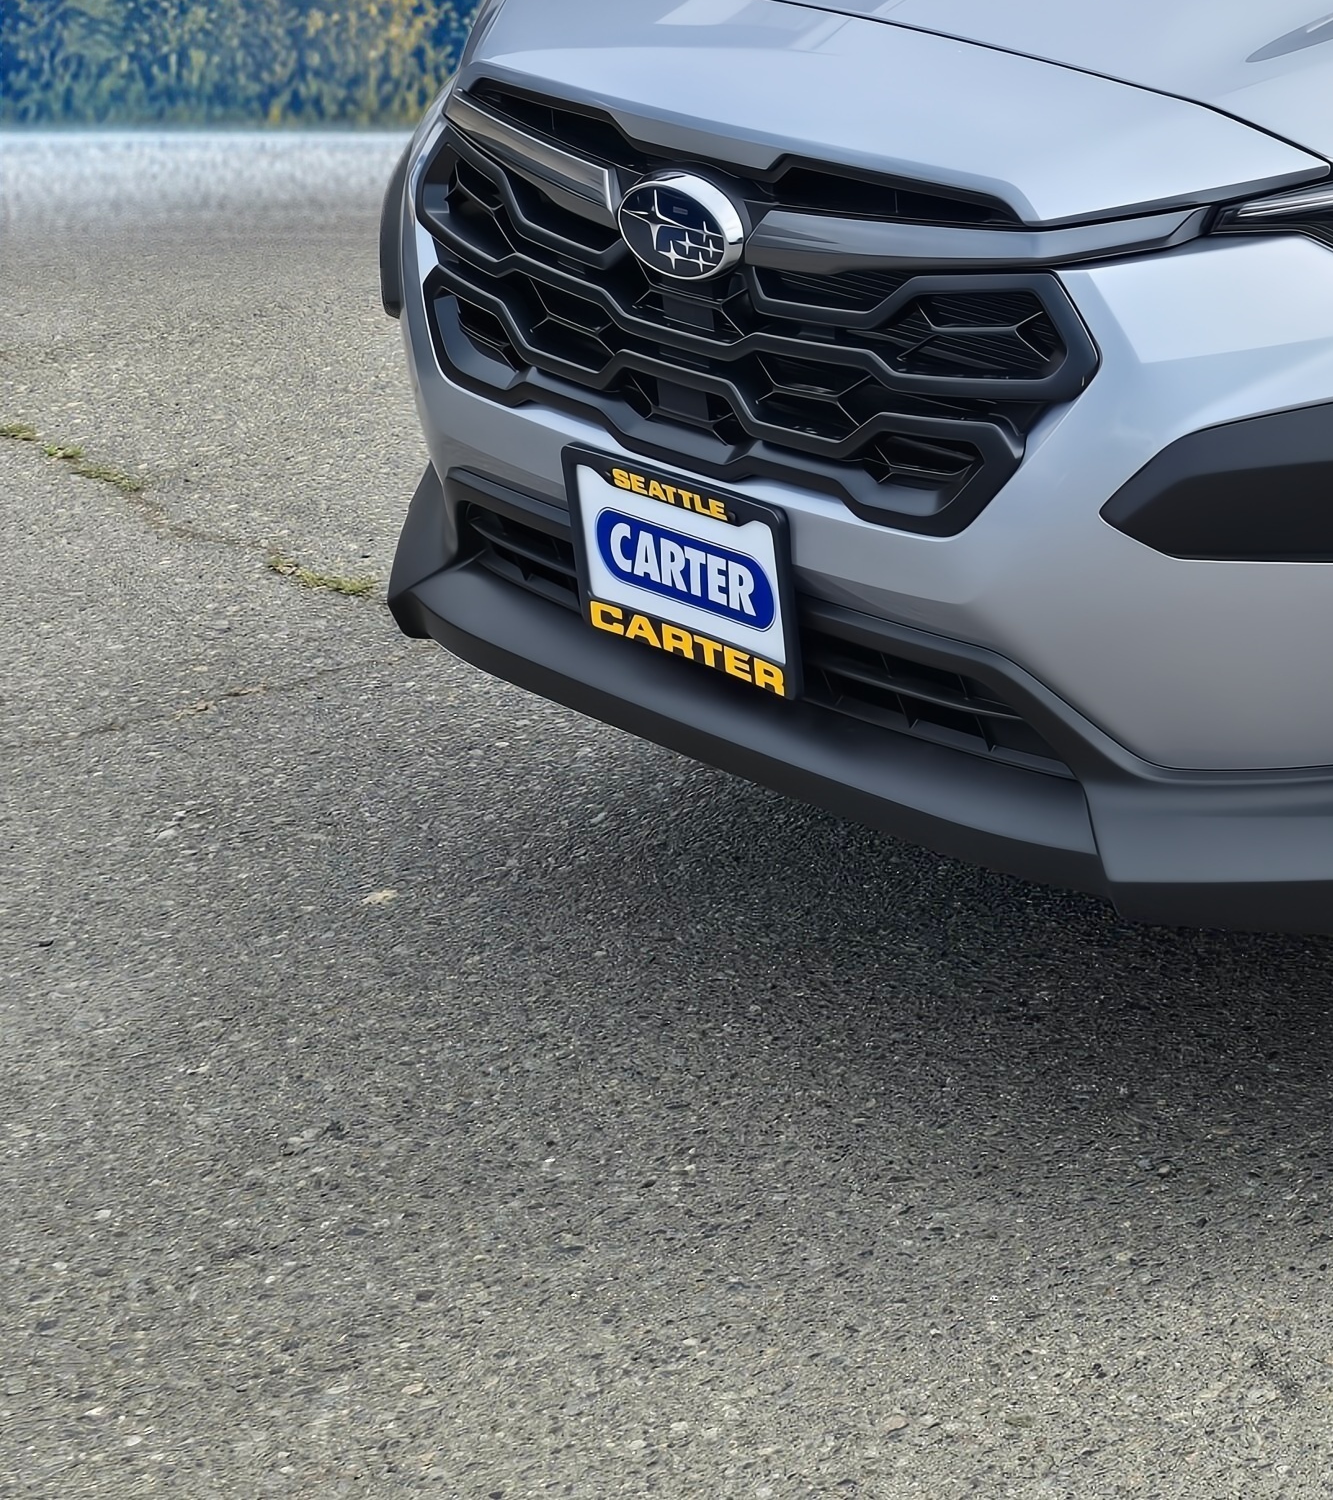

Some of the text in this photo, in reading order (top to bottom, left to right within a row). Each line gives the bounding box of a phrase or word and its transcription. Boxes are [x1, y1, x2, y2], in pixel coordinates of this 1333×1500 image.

[611, 467, 729, 522] SEATTLE
[610, 521, 757, 617] CARTER
[589, 600, 786, 697] CARTER
